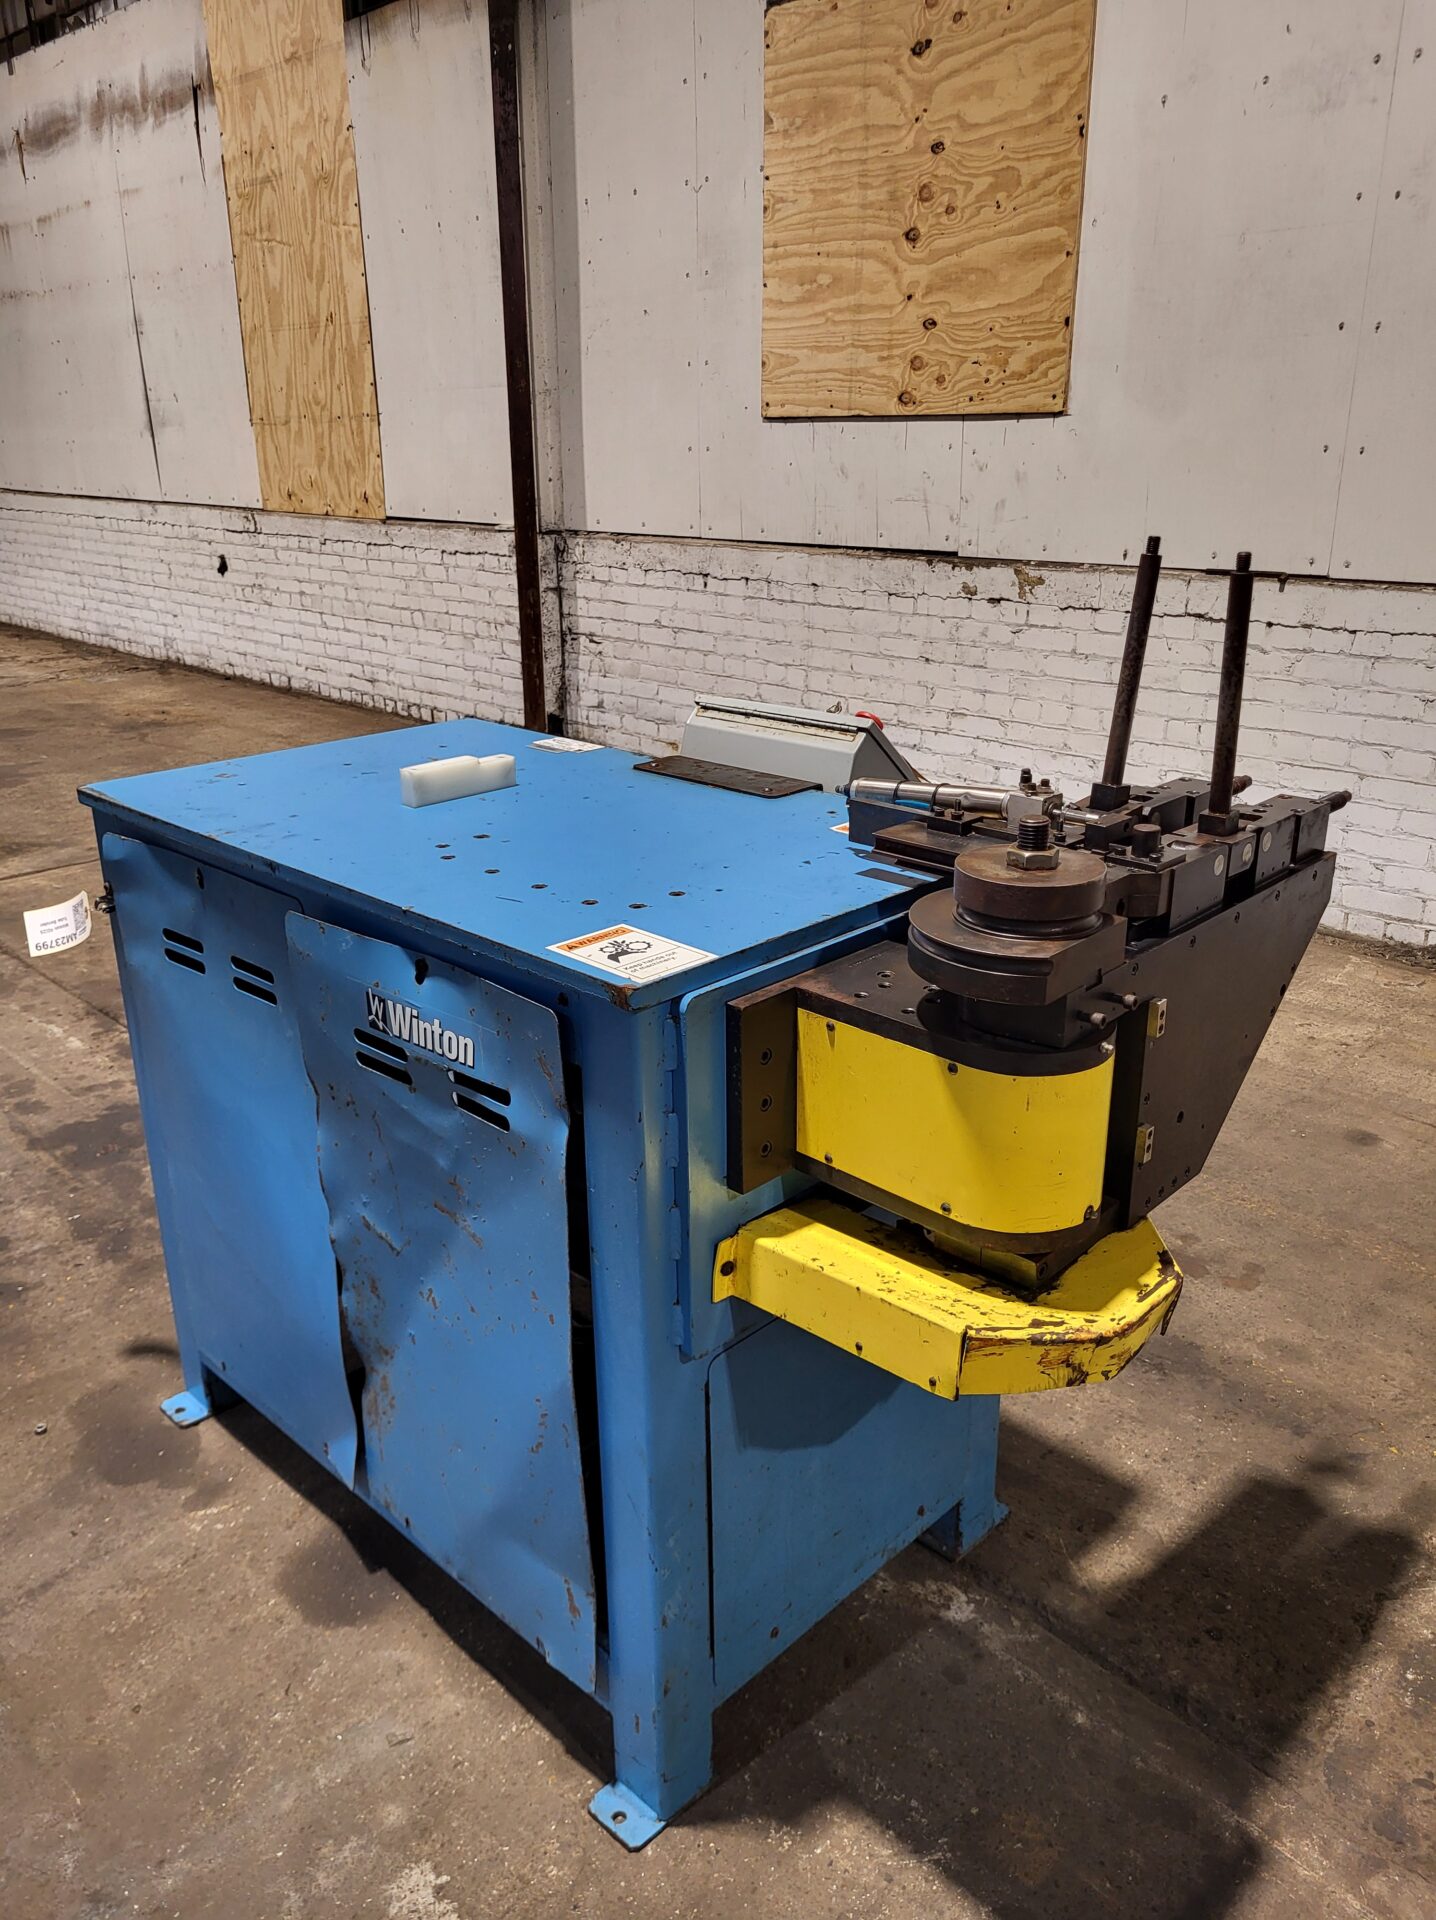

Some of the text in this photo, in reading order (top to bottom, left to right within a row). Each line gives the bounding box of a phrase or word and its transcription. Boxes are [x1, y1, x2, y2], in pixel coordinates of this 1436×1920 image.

[35, 932, 78, 951] AM23799
[575, 929, 626, 946] WARNING
[623, 962, 643, 970] Keep
[642, 955, 665, 964] hands
[387, 1000, 475, 1068] Winton
